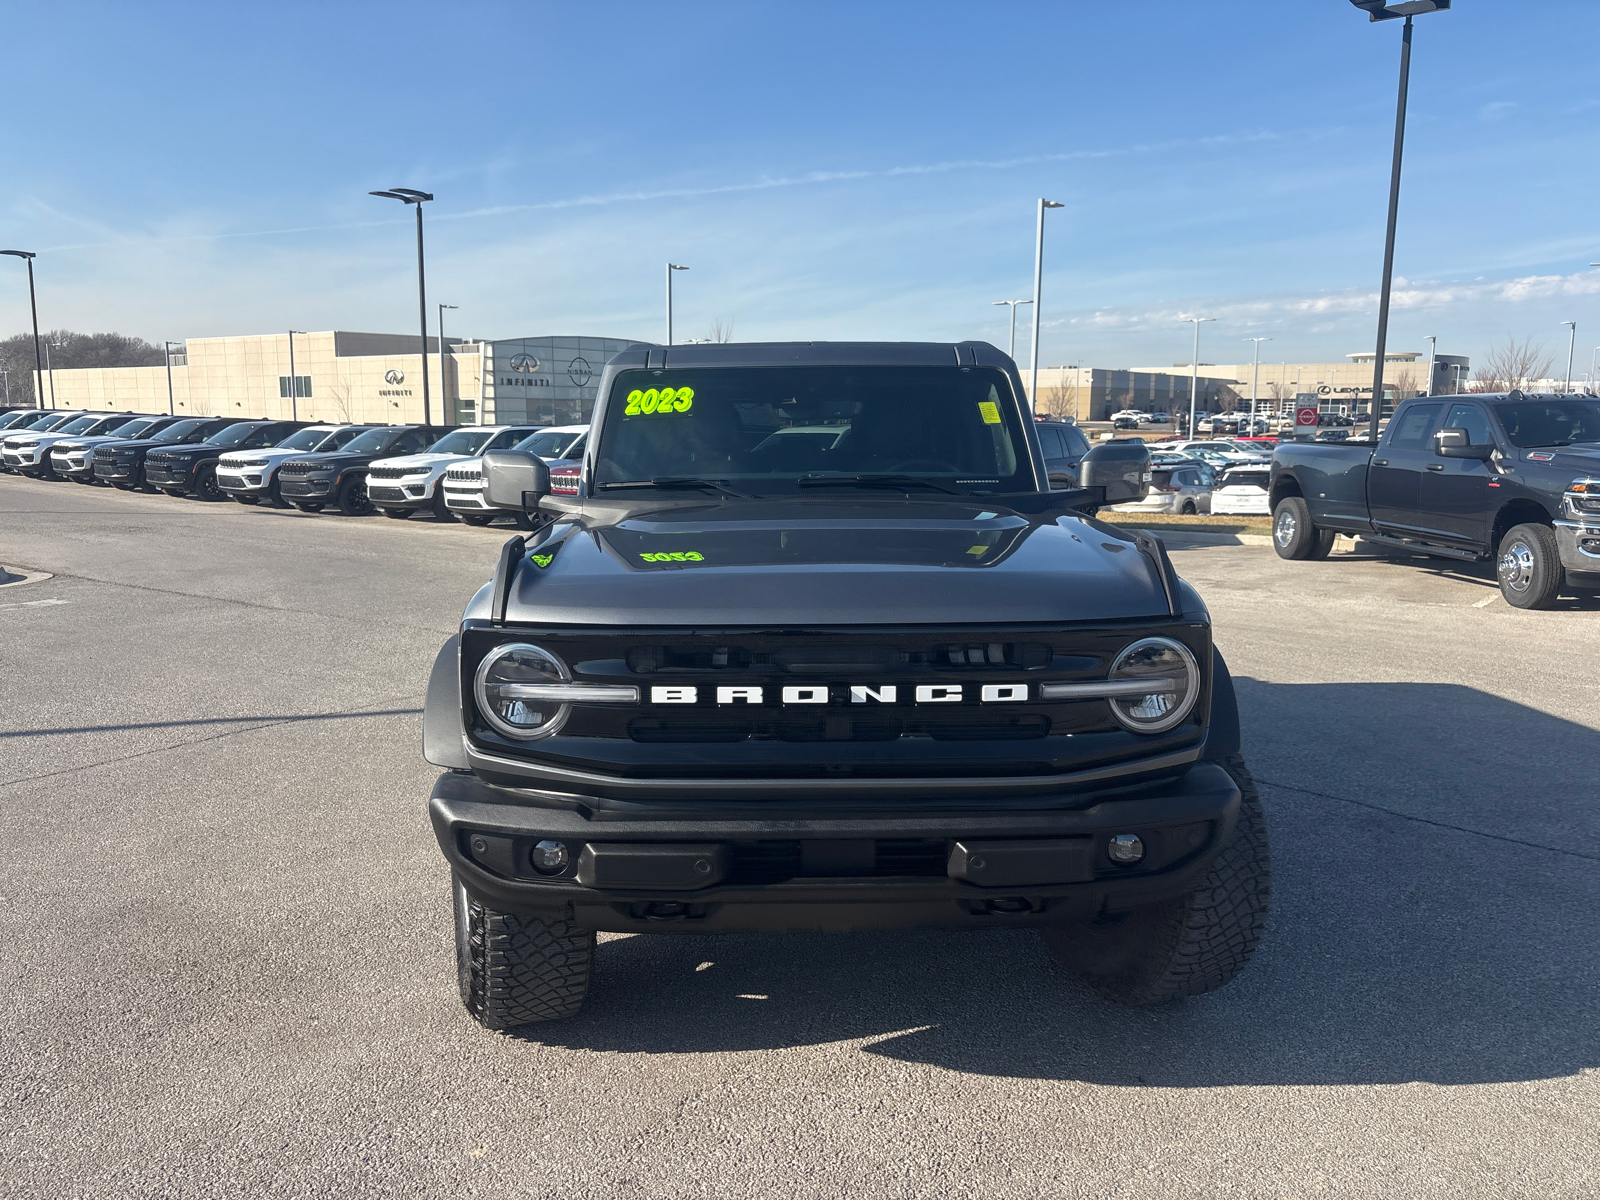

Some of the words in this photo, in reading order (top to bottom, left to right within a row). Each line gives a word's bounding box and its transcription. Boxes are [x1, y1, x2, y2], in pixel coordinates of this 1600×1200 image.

[567, 368, 593, 376] NISSAN
[501, 377, 550, 387] INFINITI
[378, 389, 413, 397] INFINITI
[624, 386, 695, 416] 2023
[650, 684, 1029, 704] BRONCO
